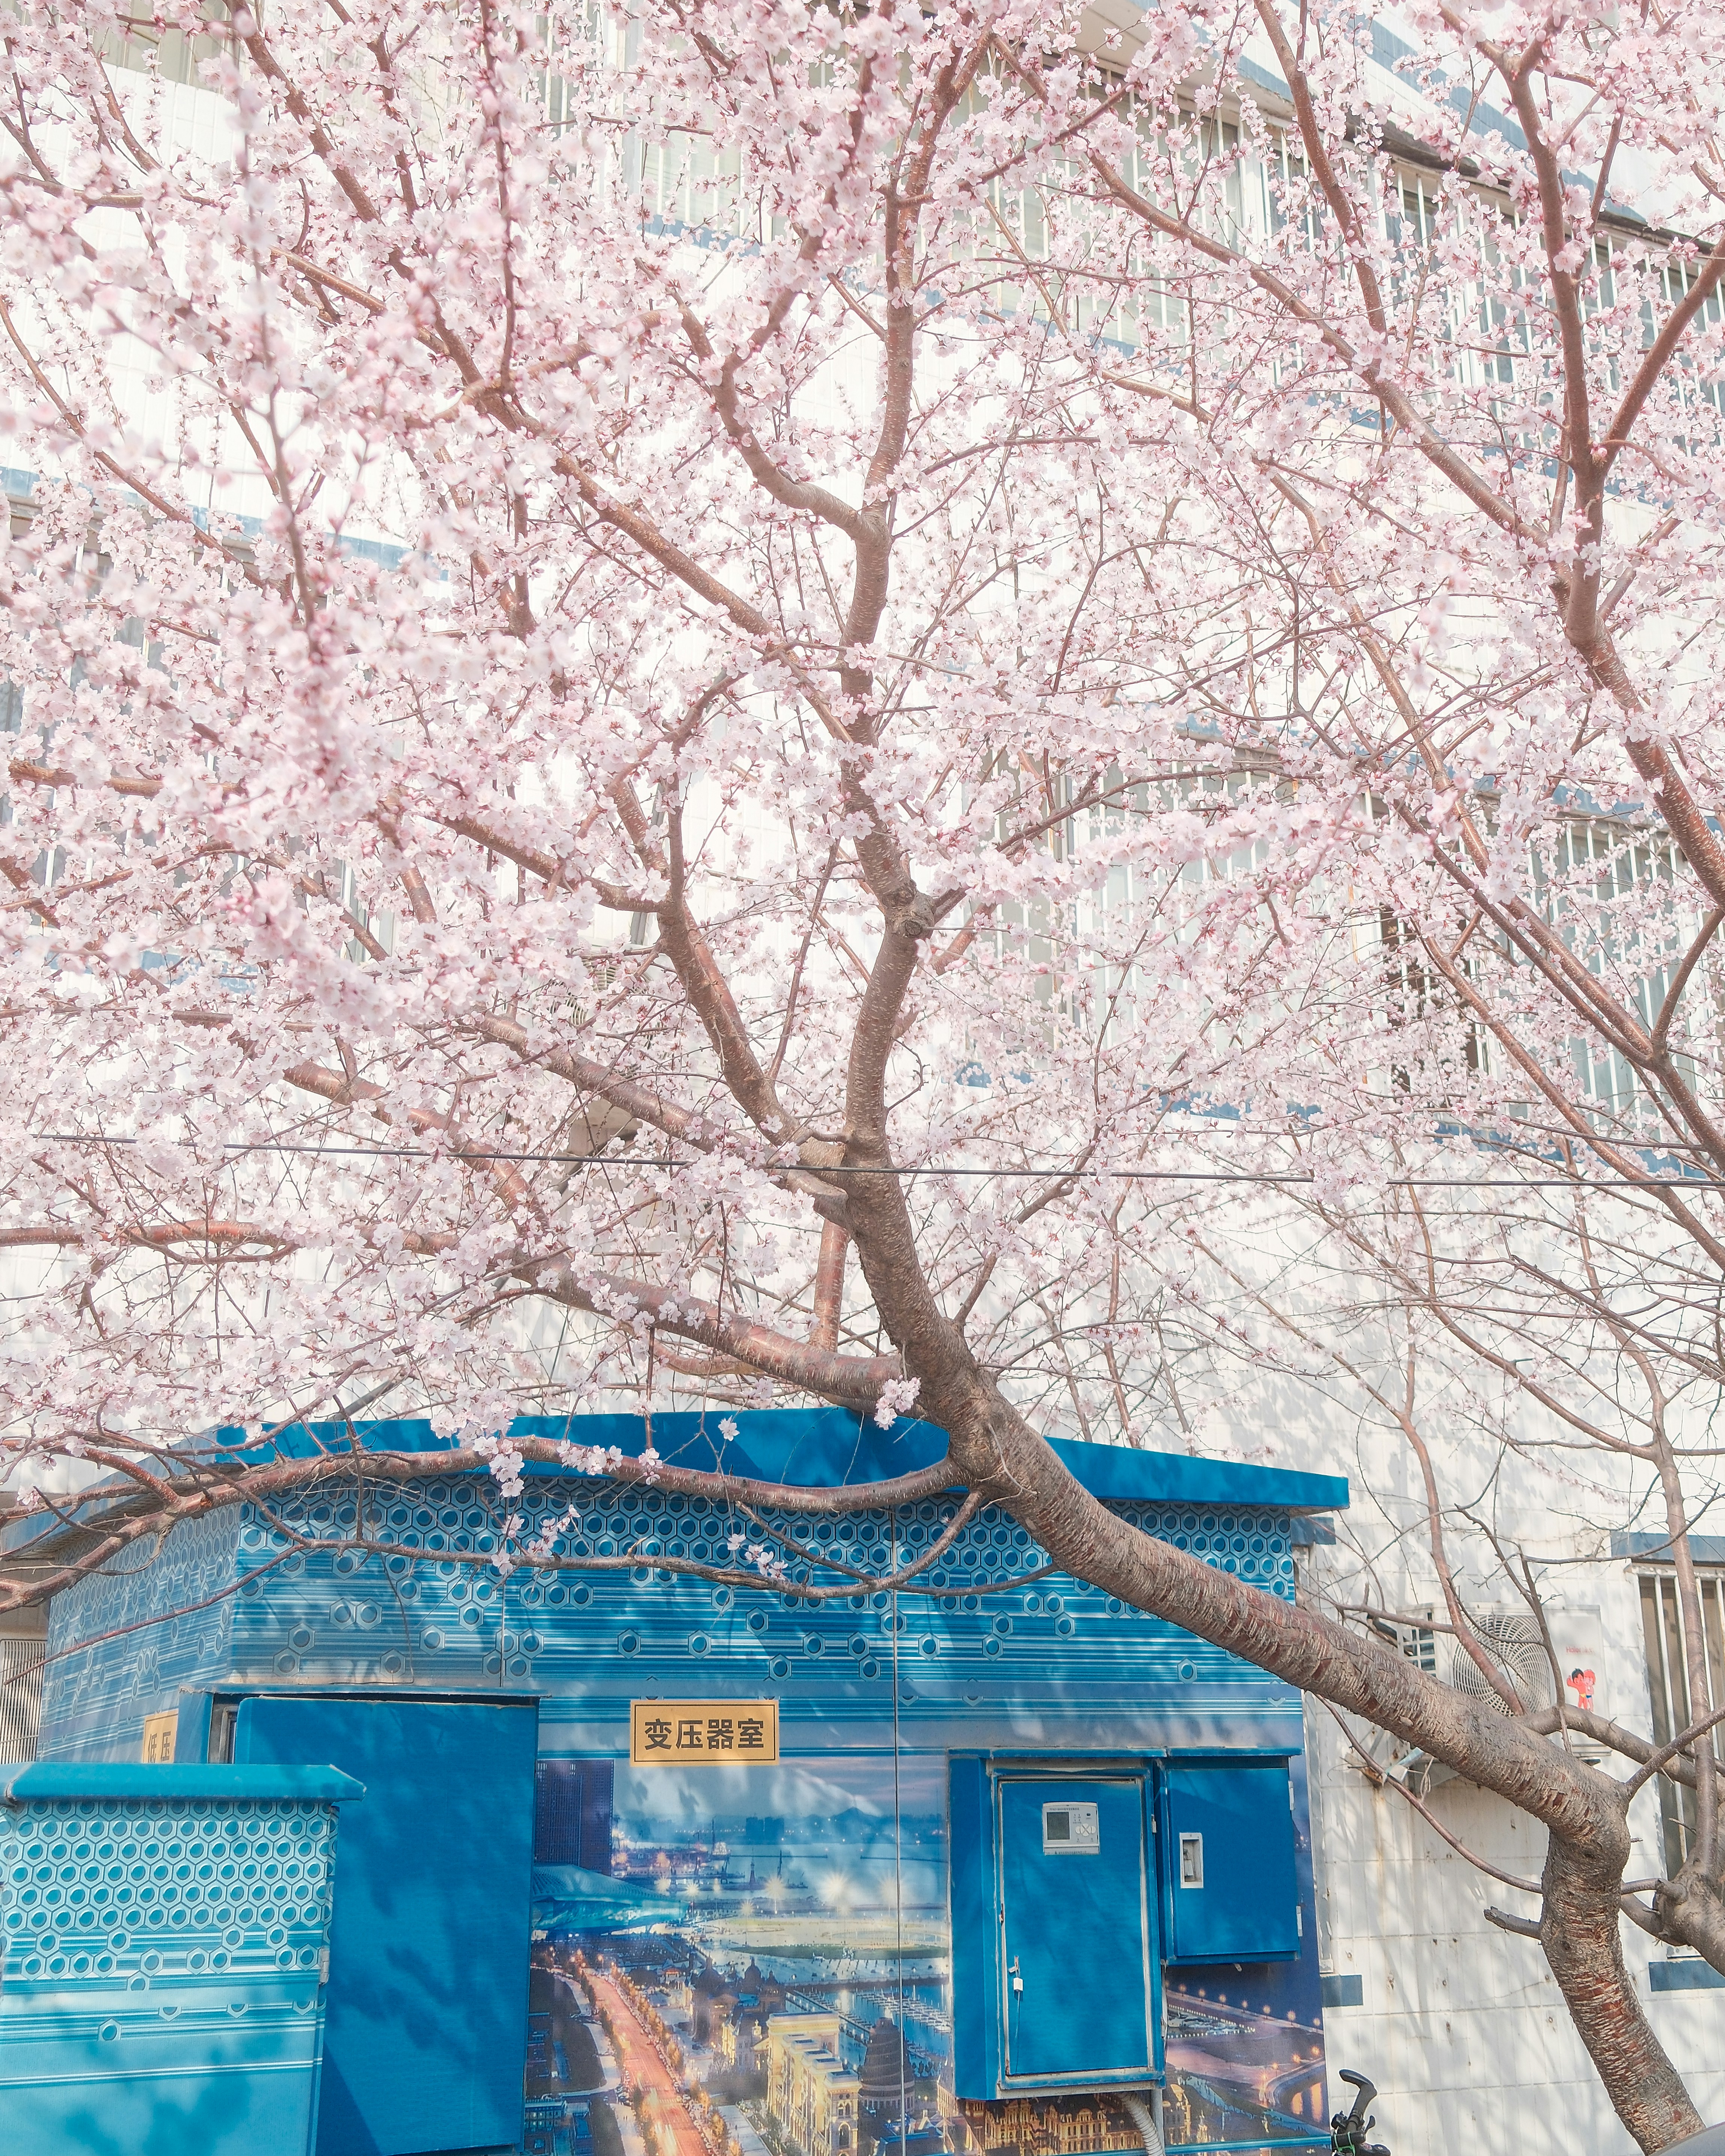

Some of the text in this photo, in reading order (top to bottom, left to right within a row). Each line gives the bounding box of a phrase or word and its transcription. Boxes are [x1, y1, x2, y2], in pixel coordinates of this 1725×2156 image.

[148, 1731, 171, 1763] 低压
[644, 1718, 764, 1750] 变压器室
